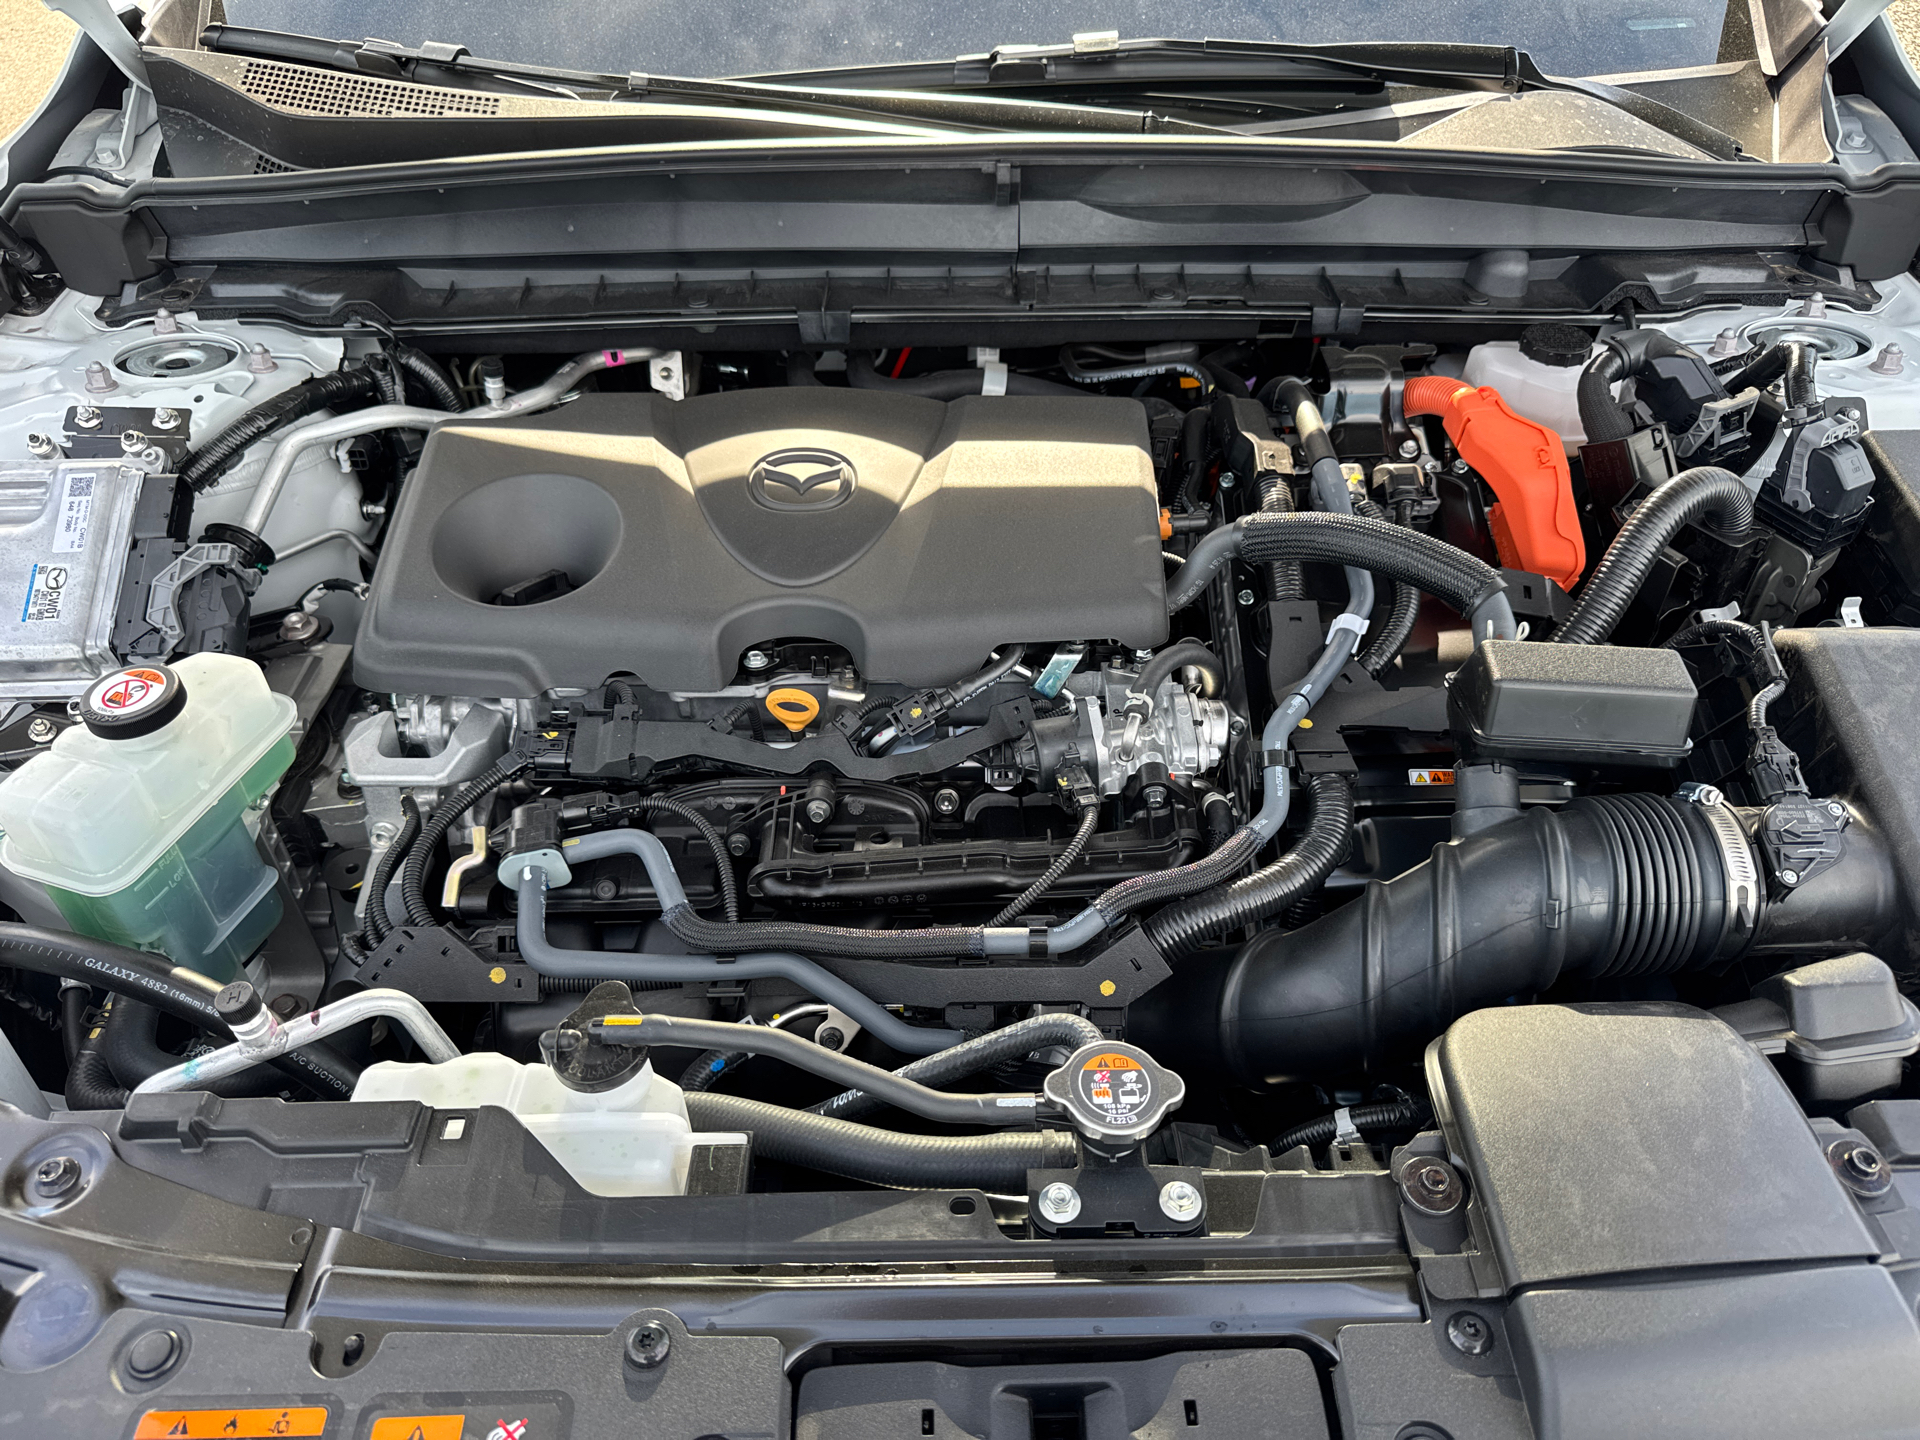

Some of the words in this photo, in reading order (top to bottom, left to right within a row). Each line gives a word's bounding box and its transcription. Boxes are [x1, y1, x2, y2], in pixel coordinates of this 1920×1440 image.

[44, 590, 62, 619] CW01
[168, 866, 186, 888] LOW
[85, 957, 140, 982] GALAXY
[140, 976, 170, 995] 4882
[170, 988, 205, 1014] (16mm)
[288, 1052, 308, 1069] A/C
[308, 1061, 348, 1097] SUCTION
[1106, 1116, 1127, 1125] FL22
